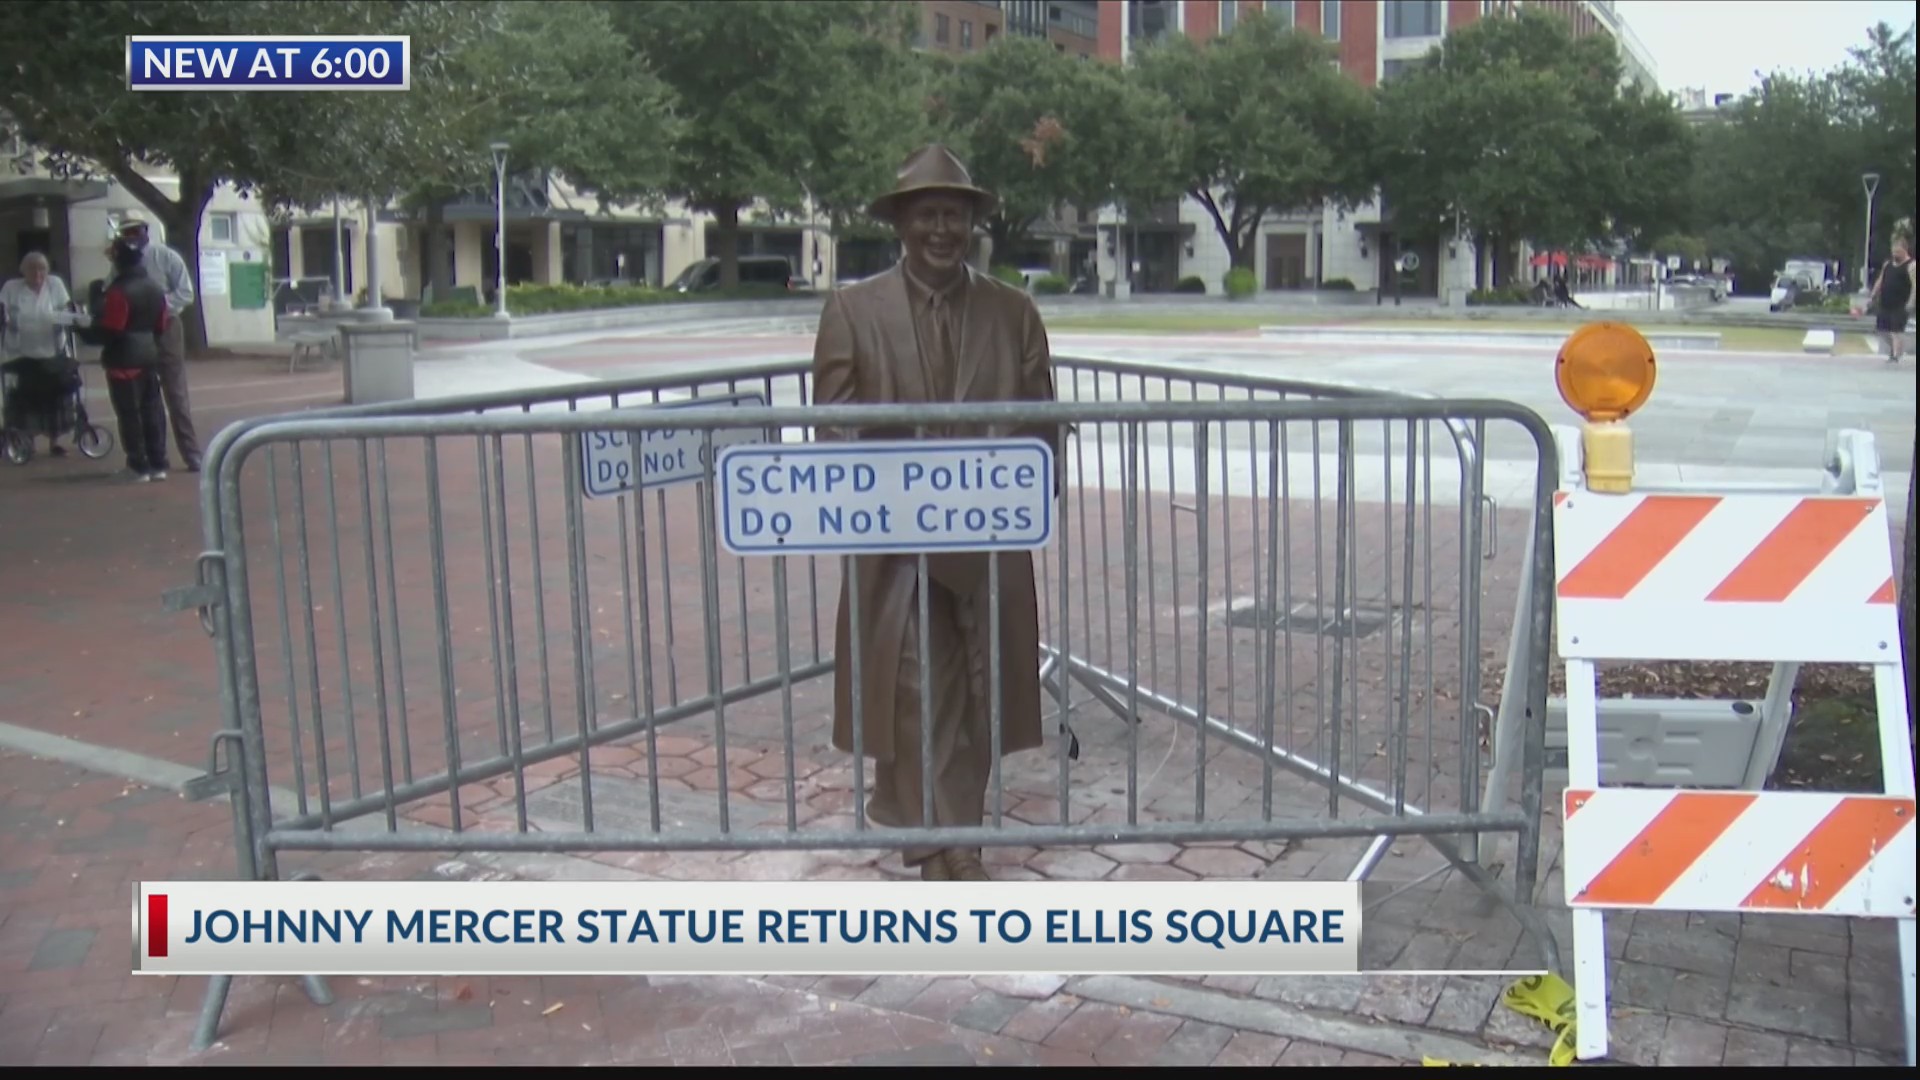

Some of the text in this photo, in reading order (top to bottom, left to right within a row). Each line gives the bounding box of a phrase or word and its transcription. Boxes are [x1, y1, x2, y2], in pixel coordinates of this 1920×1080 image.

[598, 460, 629, 482] Do
[644, 448, 686, 475] Not
[735, 457, 1036, 495] SCMPD Police
[740, 503, 1032, 536] Do Not Cross
